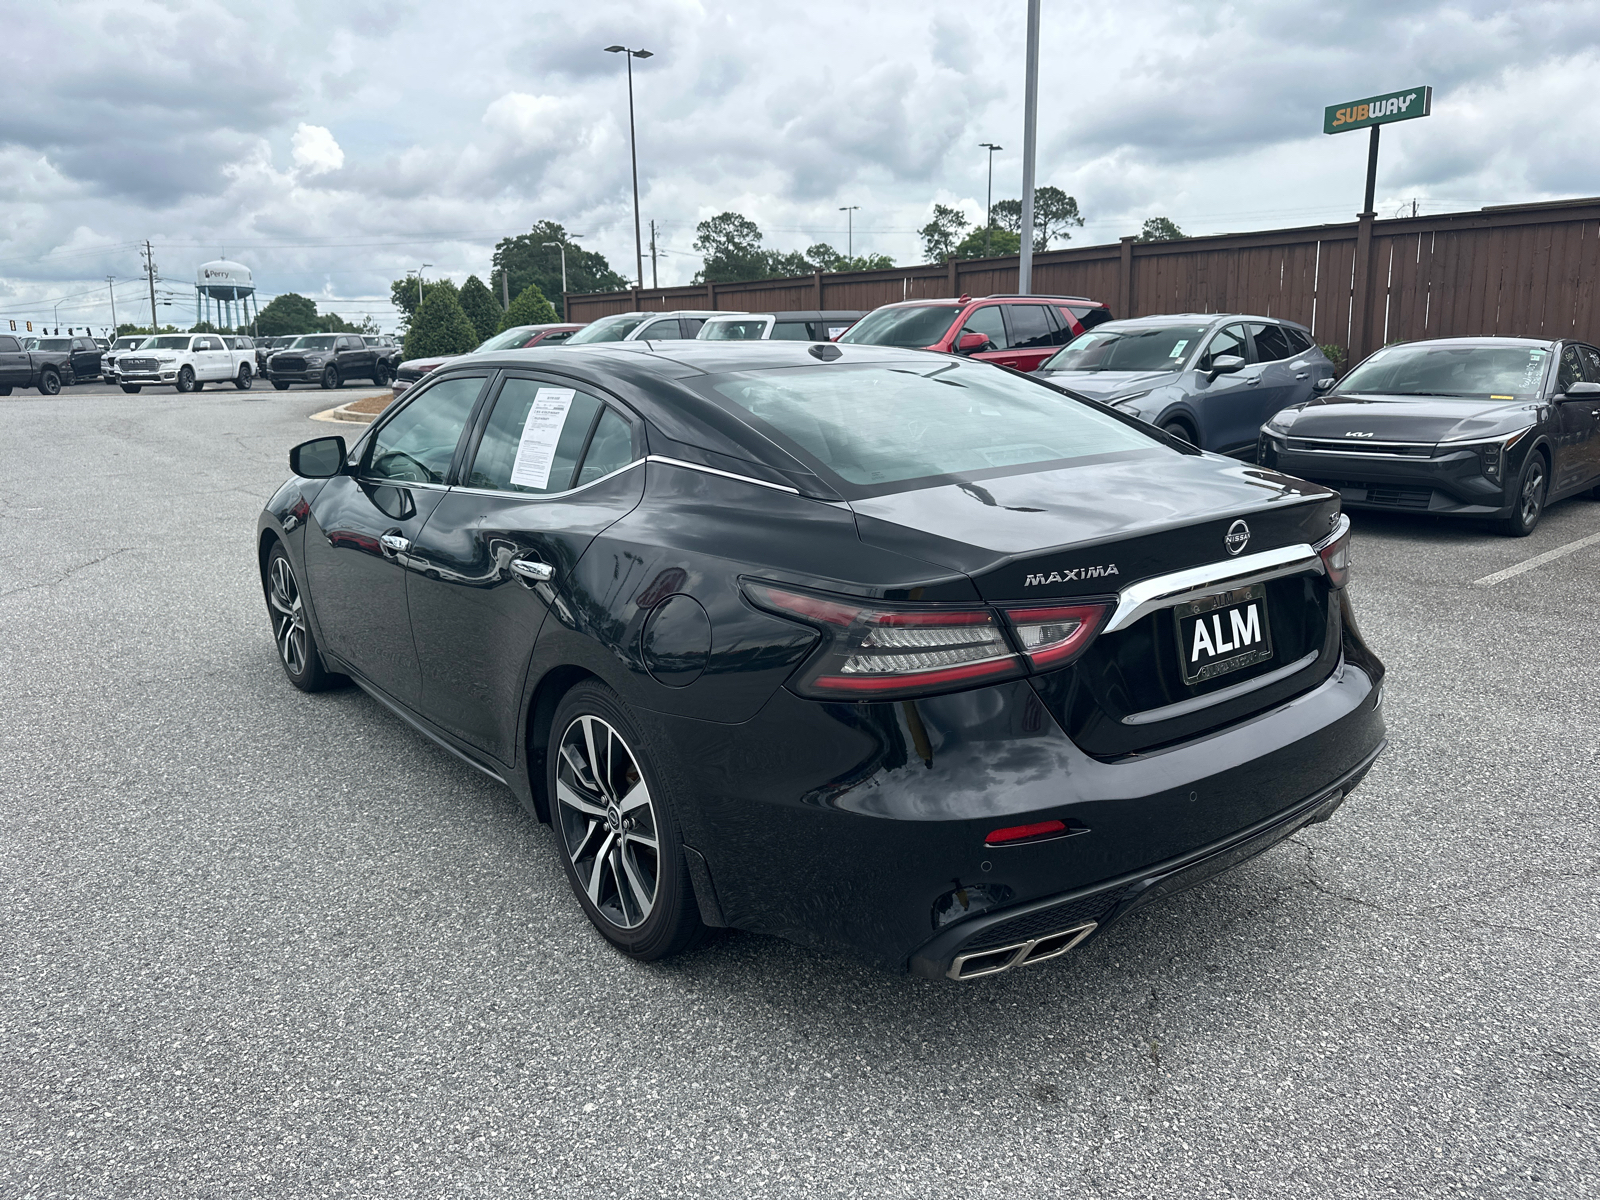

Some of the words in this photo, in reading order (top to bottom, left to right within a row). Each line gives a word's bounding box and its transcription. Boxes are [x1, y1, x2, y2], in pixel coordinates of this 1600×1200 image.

[1332, 93, 1417, 127] SUBWAY
[209, 270, 229, 279] Perry
[1225, 531, 1251, 544] NISSAN
[1024, 563, 1120, 587] MAXIMA
[1191, 603, 1262, 663] ALM
